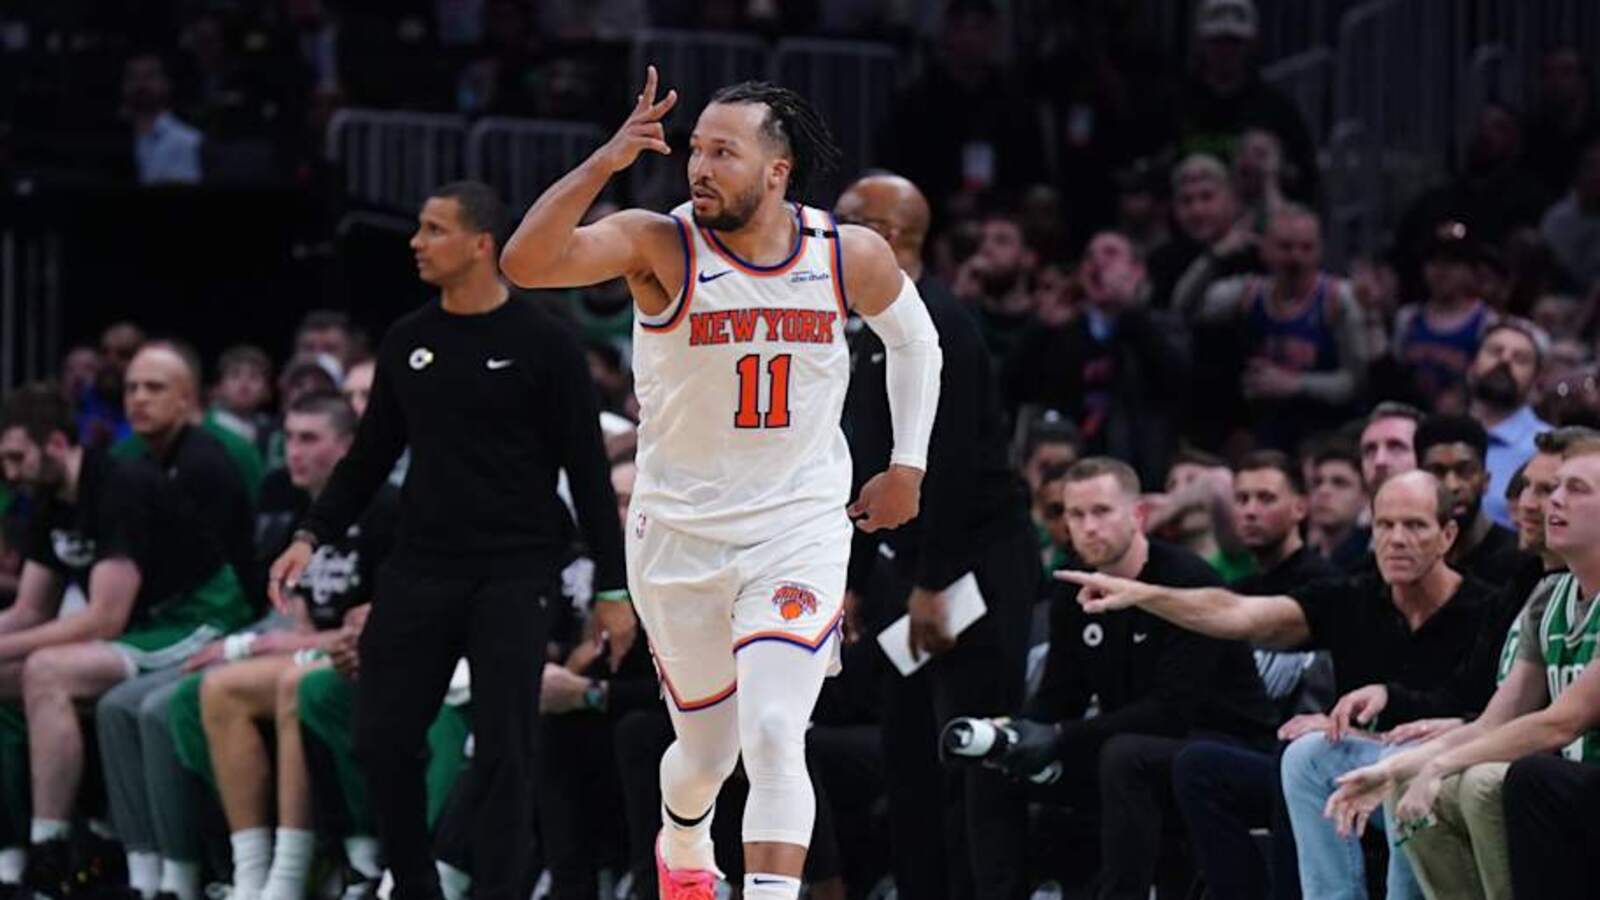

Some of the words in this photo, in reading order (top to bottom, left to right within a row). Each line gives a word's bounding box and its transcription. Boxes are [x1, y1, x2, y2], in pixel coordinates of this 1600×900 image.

[689, 308, 759, 346] NEW
[762, 308, 837, 344] YORK
[734, 354, 791, 428] 11
